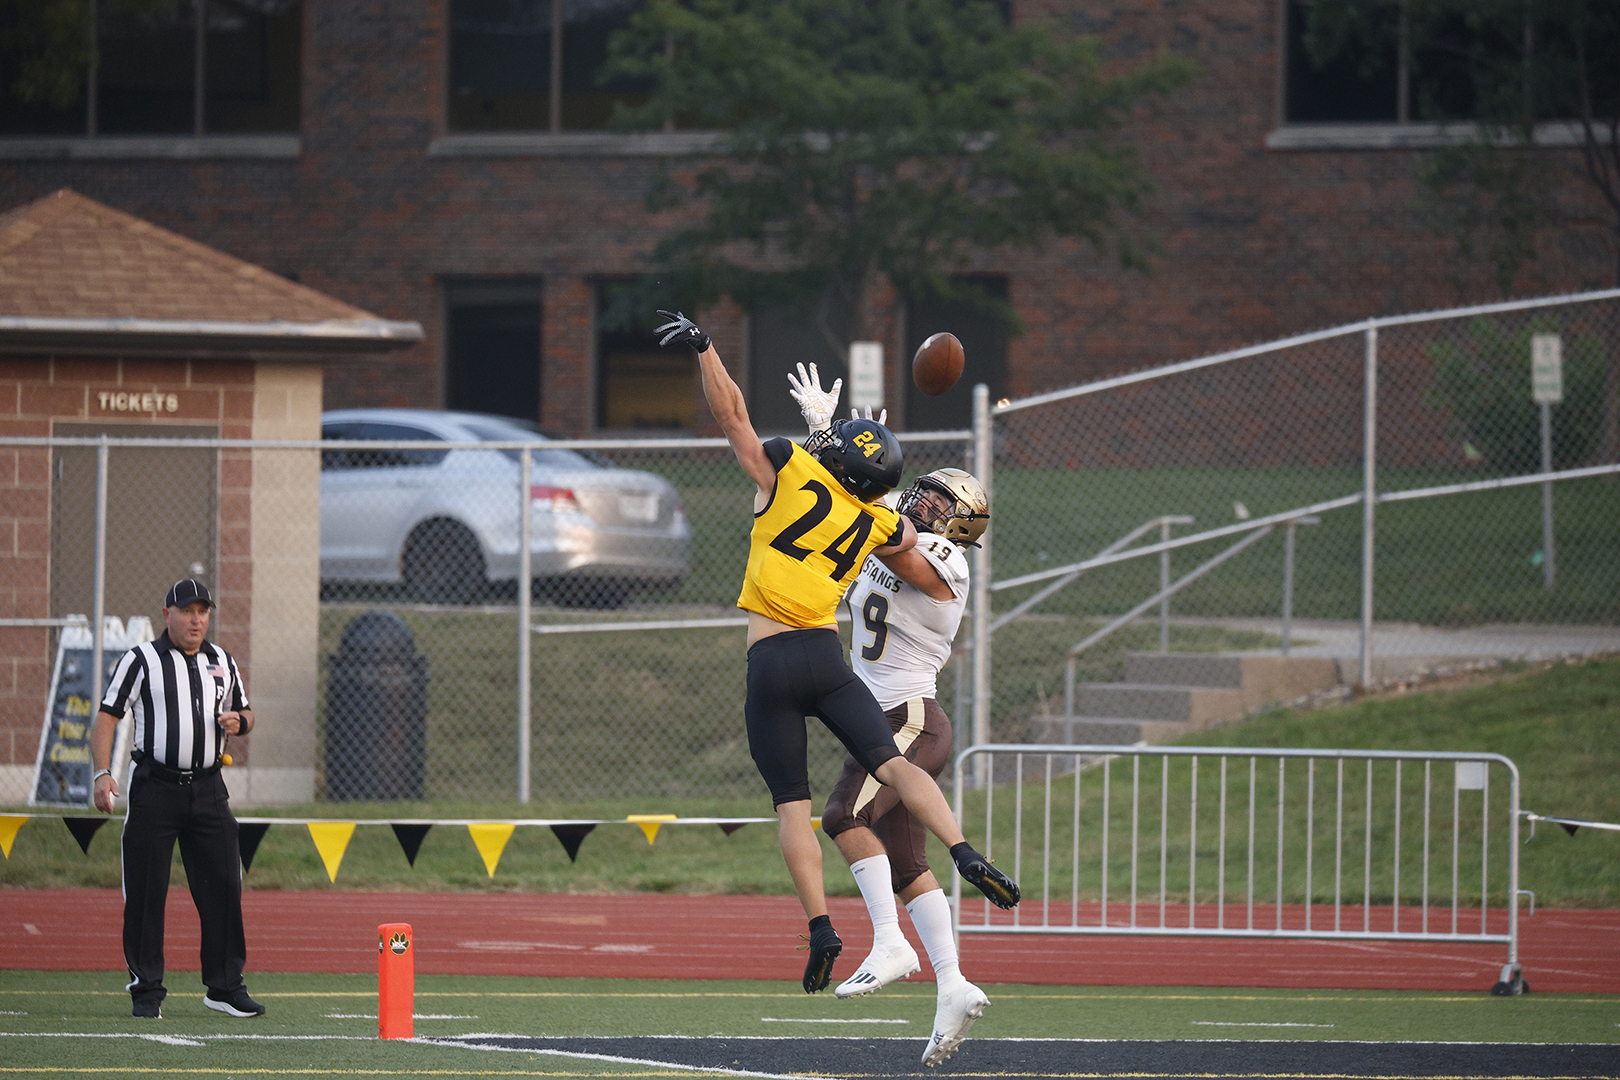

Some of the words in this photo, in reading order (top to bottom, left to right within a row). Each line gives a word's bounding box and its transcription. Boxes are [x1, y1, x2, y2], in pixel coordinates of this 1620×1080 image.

[98, 391, 179, 413] TICKETS
[852, 430, 882, 458] 24
[768, 479, 875, 583] 24
[928, 541, 952, 562] 19
[863, 556, 903, 593] STANGS
